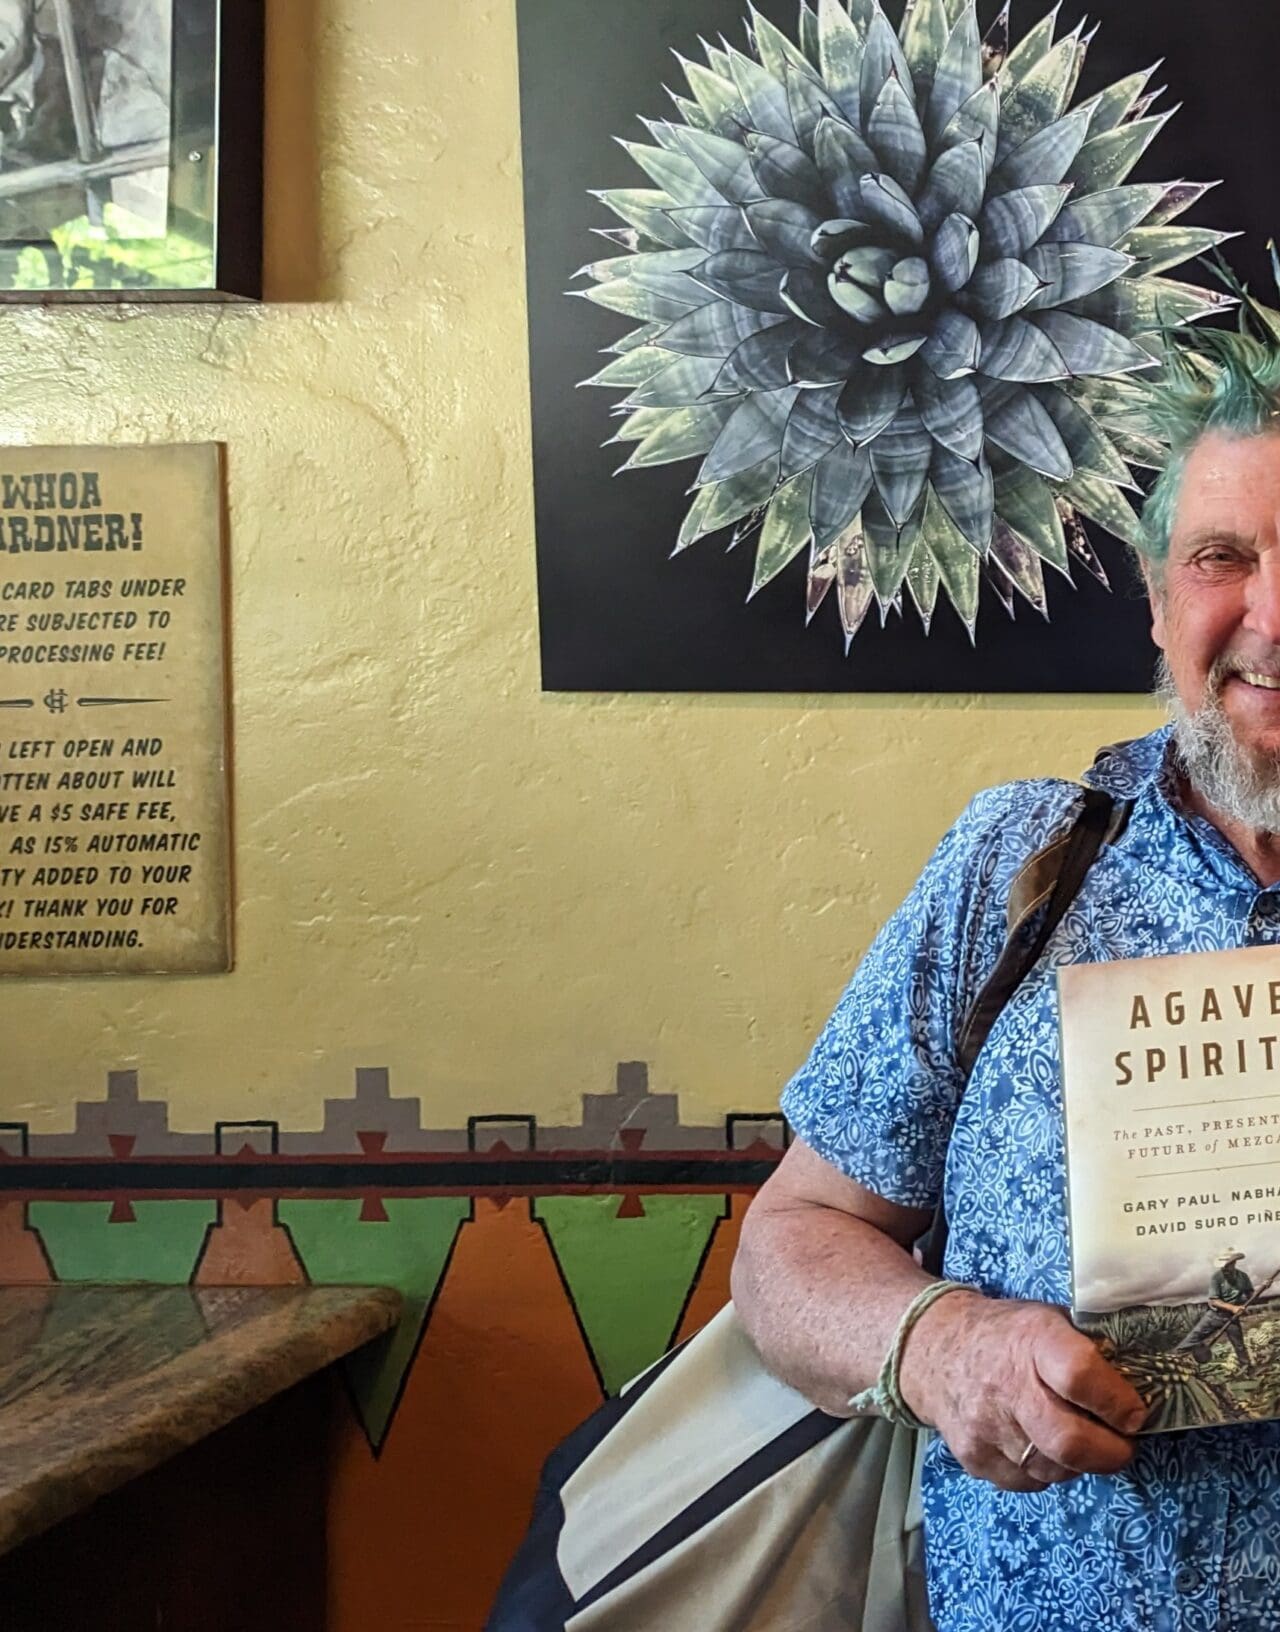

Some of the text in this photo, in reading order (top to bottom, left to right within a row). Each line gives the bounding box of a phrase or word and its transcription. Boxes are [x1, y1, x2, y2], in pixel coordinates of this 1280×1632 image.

[1, 471, 102, 510] WHOA
[2, 578, 187, 600] CARD TABS UNDER
[26, 611, 138, 632] SUBJECTED
[147, 610, 170, 629] TO
[0, 642, 167, 664] PROCESSING FEE!
[8, 737, 163, 759] LEFT OPEN AND
[0, 770, 177, 791] TTEN ABOUT WILL
[28, 804, 42, 823] A
[50, 803, 73, 822] $5
[79, 802, 130, 821] SAFE
[136, 801, 177, 823] FEE,
[9, 832, 201, 855] AS 15% AUTOMATIC
[31, 866, 99, 886] ADDED
[109, 866, 132, 884] TO
[142, 864, 193, 884] YOUR
[24, 898, 88, 918] THANK
[96, 897, 134, 916] YOU
[140, 897, 178, 916] FOR
[0, 929, 144, 950] DERSTANDING.
[1113, 1129, 1138, 1142] The
[1144, 1123, 1194, 1139] PAST,
[1127, 1142, 1198, 1160] FUTURE
[1205, 1139, 1219, 1153] of
[1123, 1198, 1169, 1214] GARY
[1177, 1192, 1221, 1208] PAUL
[1136, 1221, 1187, 1237] DAVID
[1194, 1215, 1239, 1230] SURO
